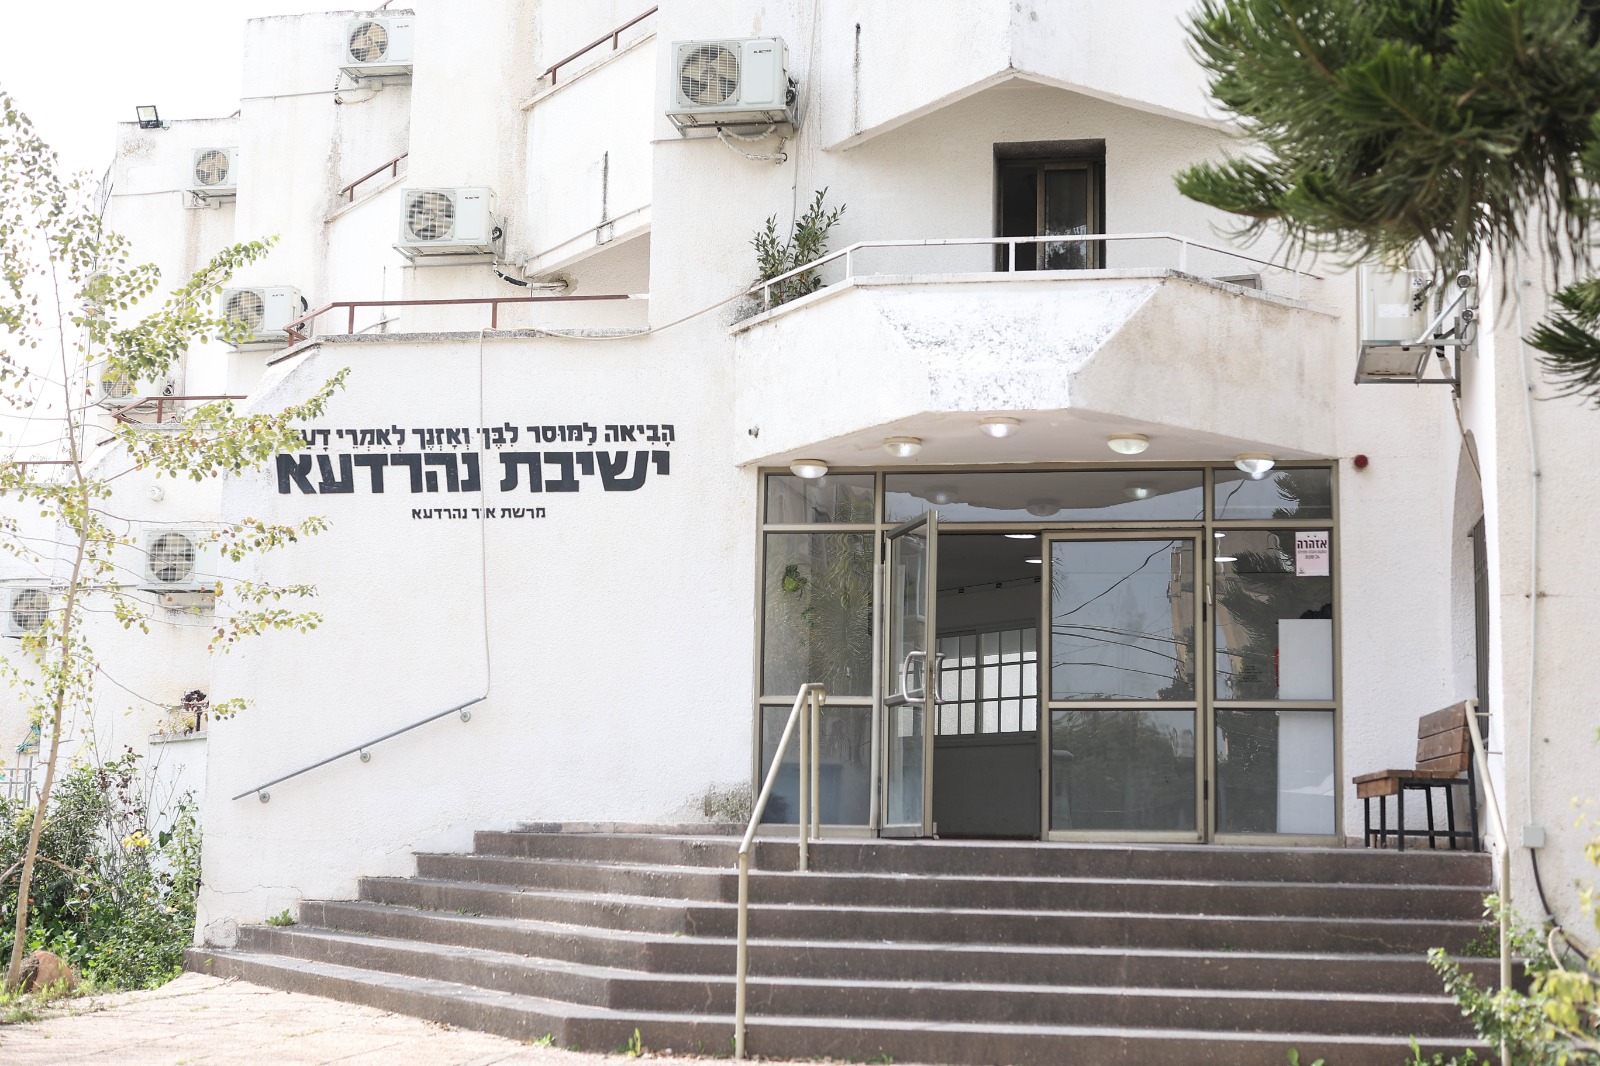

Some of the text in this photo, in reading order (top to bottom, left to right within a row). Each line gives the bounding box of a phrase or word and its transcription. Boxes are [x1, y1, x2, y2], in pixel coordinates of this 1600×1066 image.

[275, 450, 671, 495] ישיבת נהרדעא
[411, 508, 468, 520] נהרדעא
[500, 507, 546, 519] מרשת
[1297, 539, 1327, 548] אזהרה
